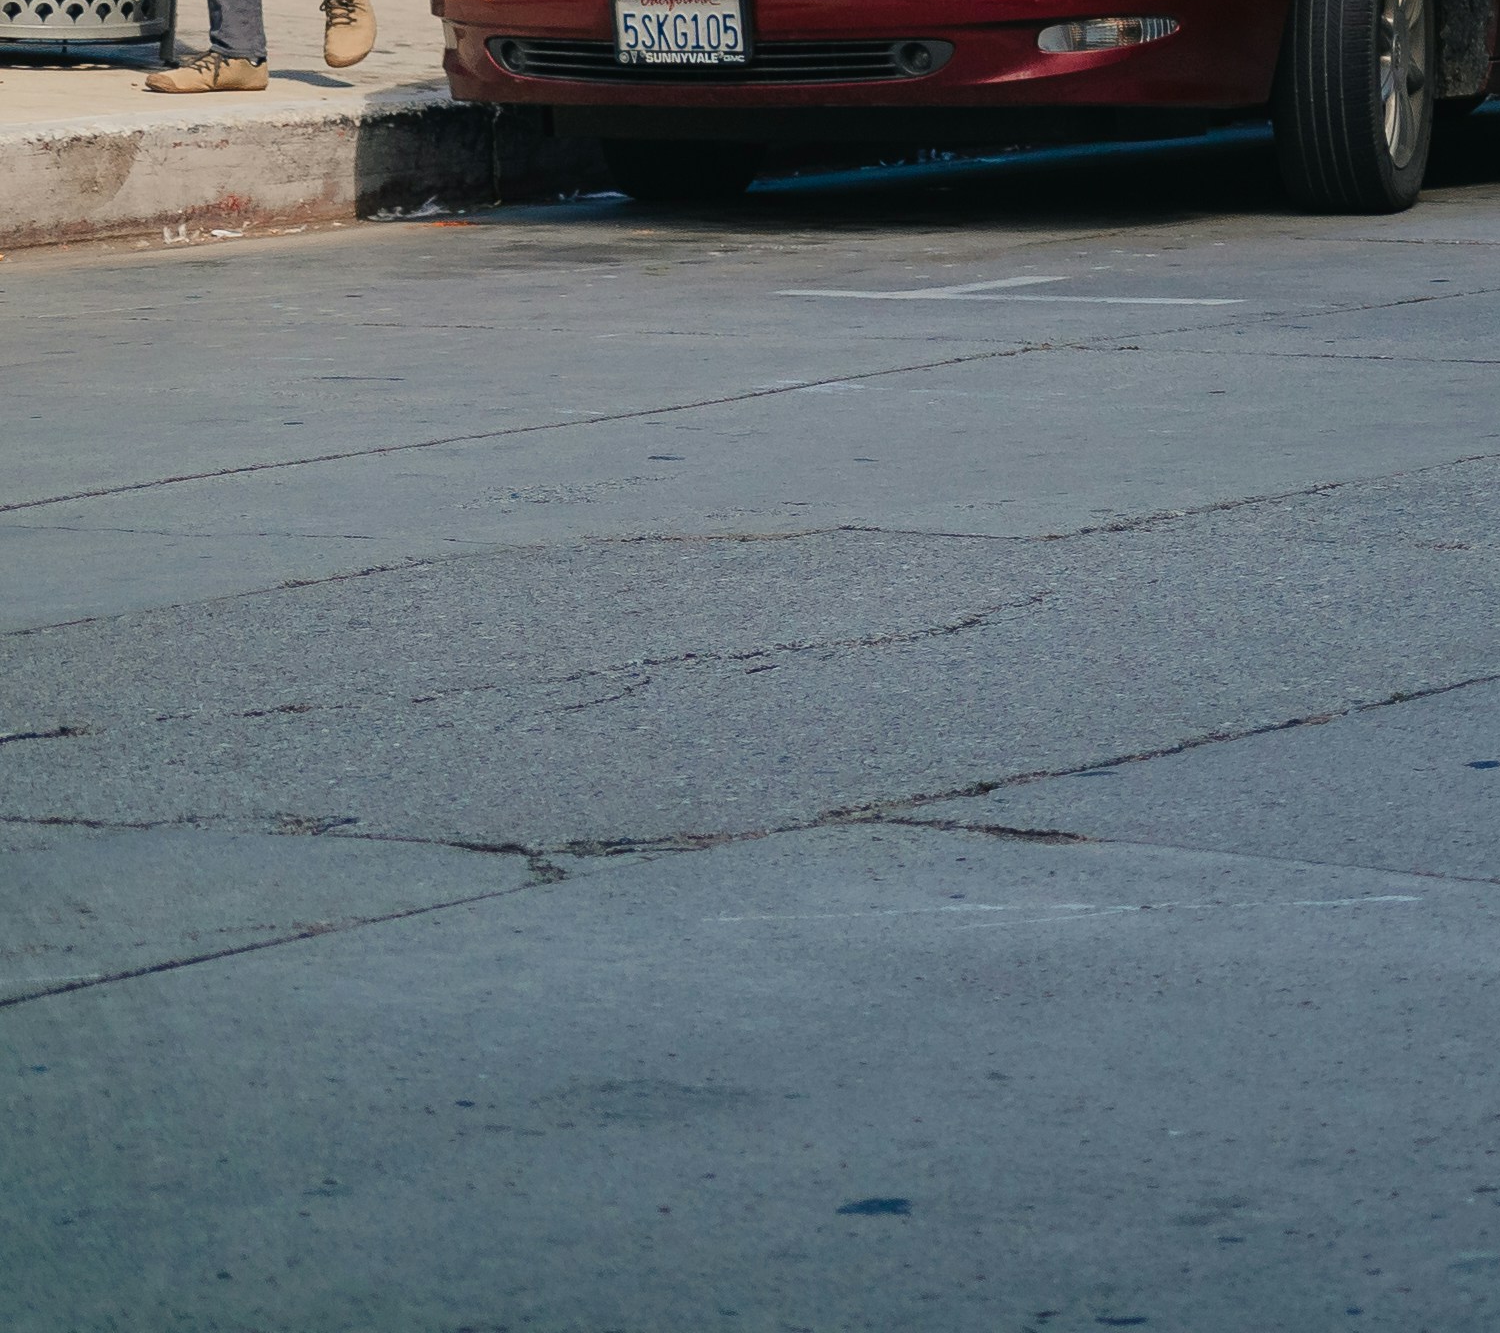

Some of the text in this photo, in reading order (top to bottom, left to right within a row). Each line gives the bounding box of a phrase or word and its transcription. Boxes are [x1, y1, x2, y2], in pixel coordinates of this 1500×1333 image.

[623, 13, 739, 50] 5SKG105
[645, 52, 745, 63] SUNNYVALE GMC
